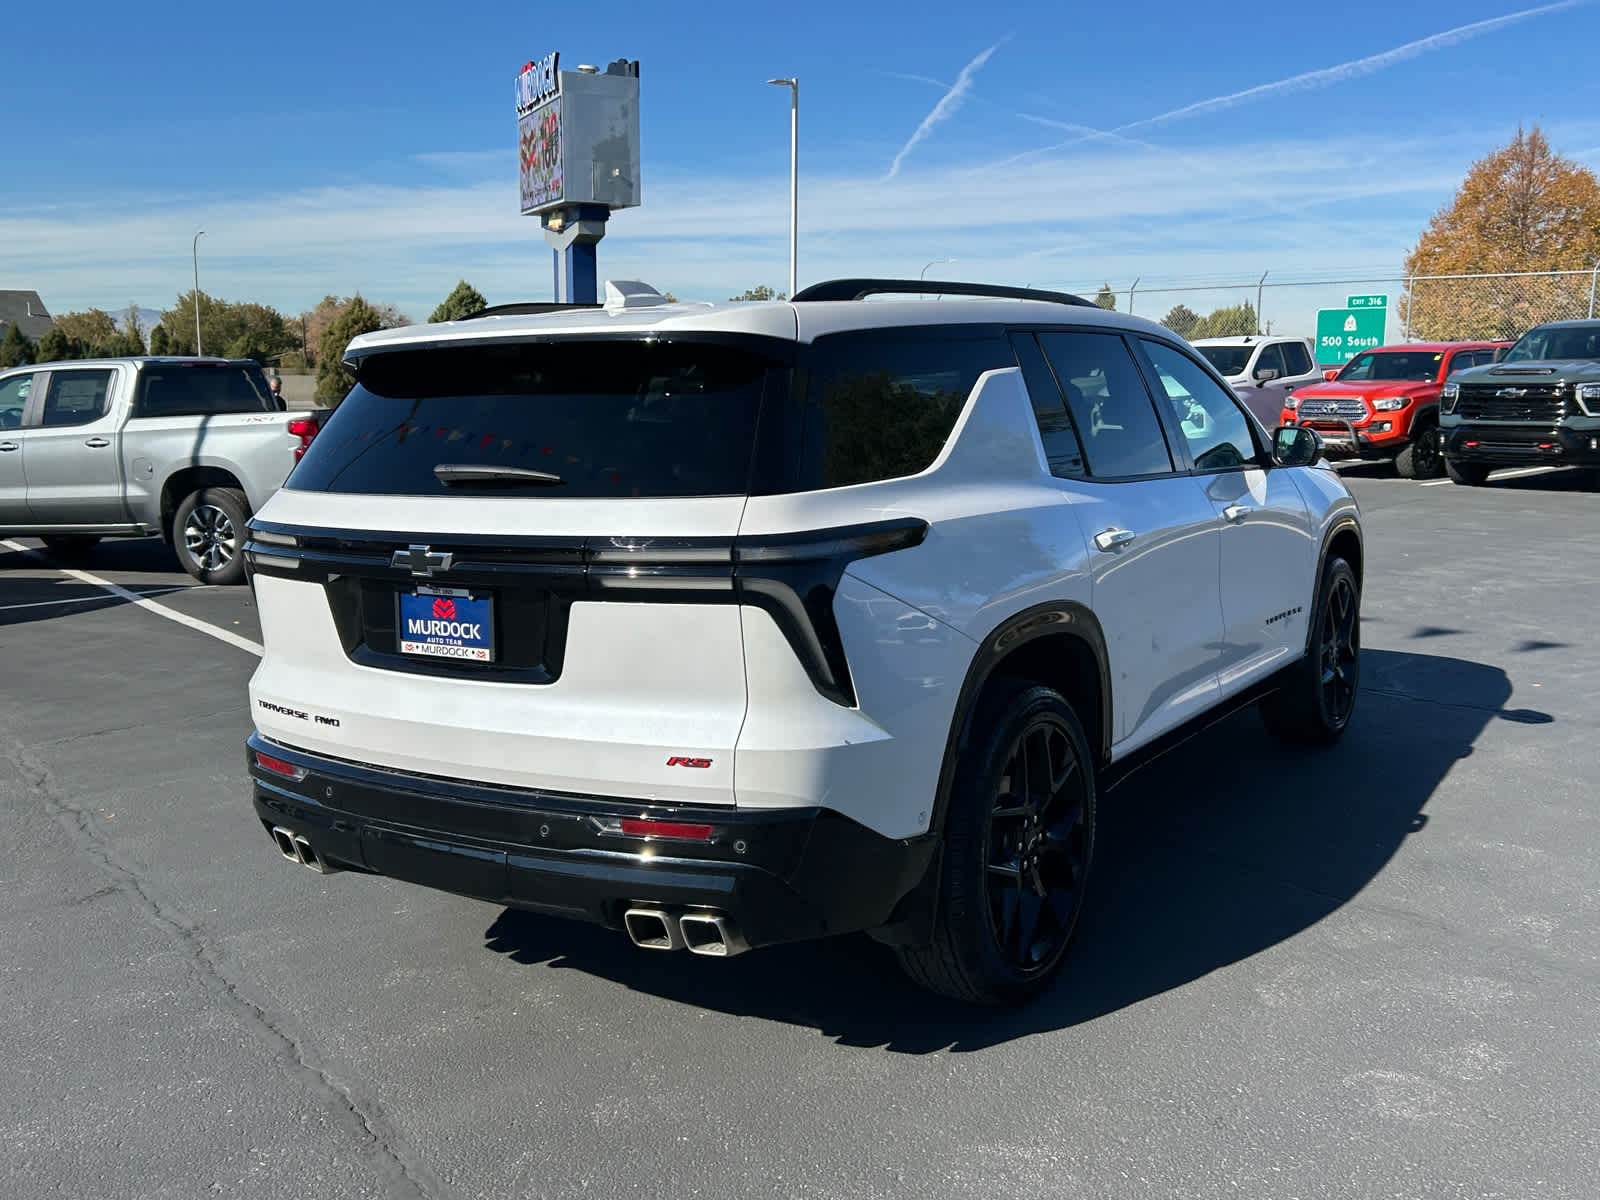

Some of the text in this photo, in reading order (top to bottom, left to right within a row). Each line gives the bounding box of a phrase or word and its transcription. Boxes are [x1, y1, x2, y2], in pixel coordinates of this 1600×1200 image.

[514, 52, 558, 112] MURDOCK
[1368, 297, 1382, 306] 316
[1321, 336, 1378, 347] 500 South
[1337, 352, 1340, 360] 1
[1266, 606, 1302, 625] TRAVERSE
[408, 619, 480, 640] MURDOCK
[446, 638, 462, 646] TEAM
[421, 644, 469, 657] MURDOCK
[257, 699, 340, 728] TRAVERSE AWD
[666, 756, 713, 769] RS
